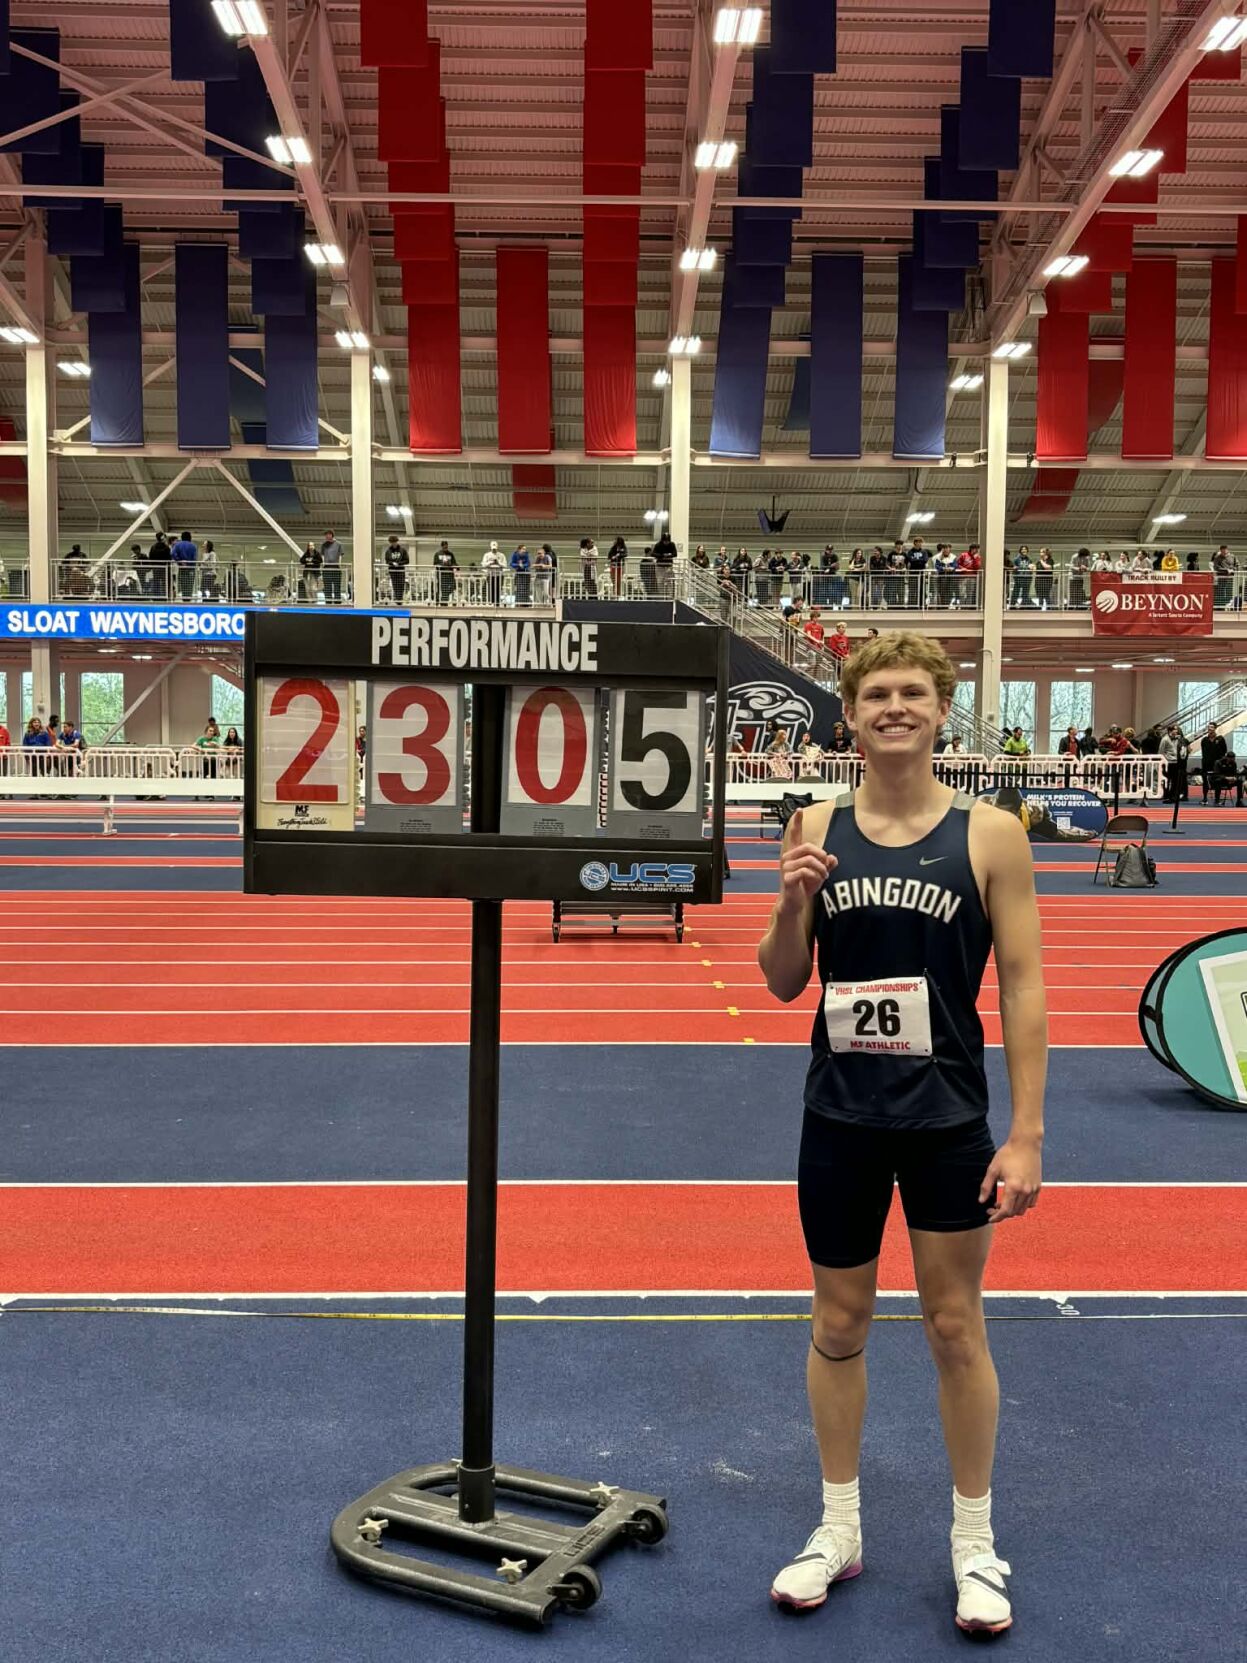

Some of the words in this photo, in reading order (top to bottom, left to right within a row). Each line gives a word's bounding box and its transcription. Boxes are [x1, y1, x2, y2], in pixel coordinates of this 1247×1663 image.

[1121, 594, 1204, 610] BEYNON
[8, 610, 80, 633] SLOAT
[89, 611, 245, 635] WAYNESBORO
[371, 617, 598, 672] PERFORMANCE
[270, 678, 340, 802] 2
[378, 685, 451, 805] 3
[515, 686, 588, 805] 0
[620, 691, 692, 812] 5
[609, 863, 696, 883] UCS
[822, 877, 962, 924] ABINGDON
[835, 986, 854, 996] VHSL
[855, 983, 919, 994] CHAMPIONSHIPS
[852, 999, 901, 1037] 26
[865, 1041, 911, 1050] ATHLETIC
